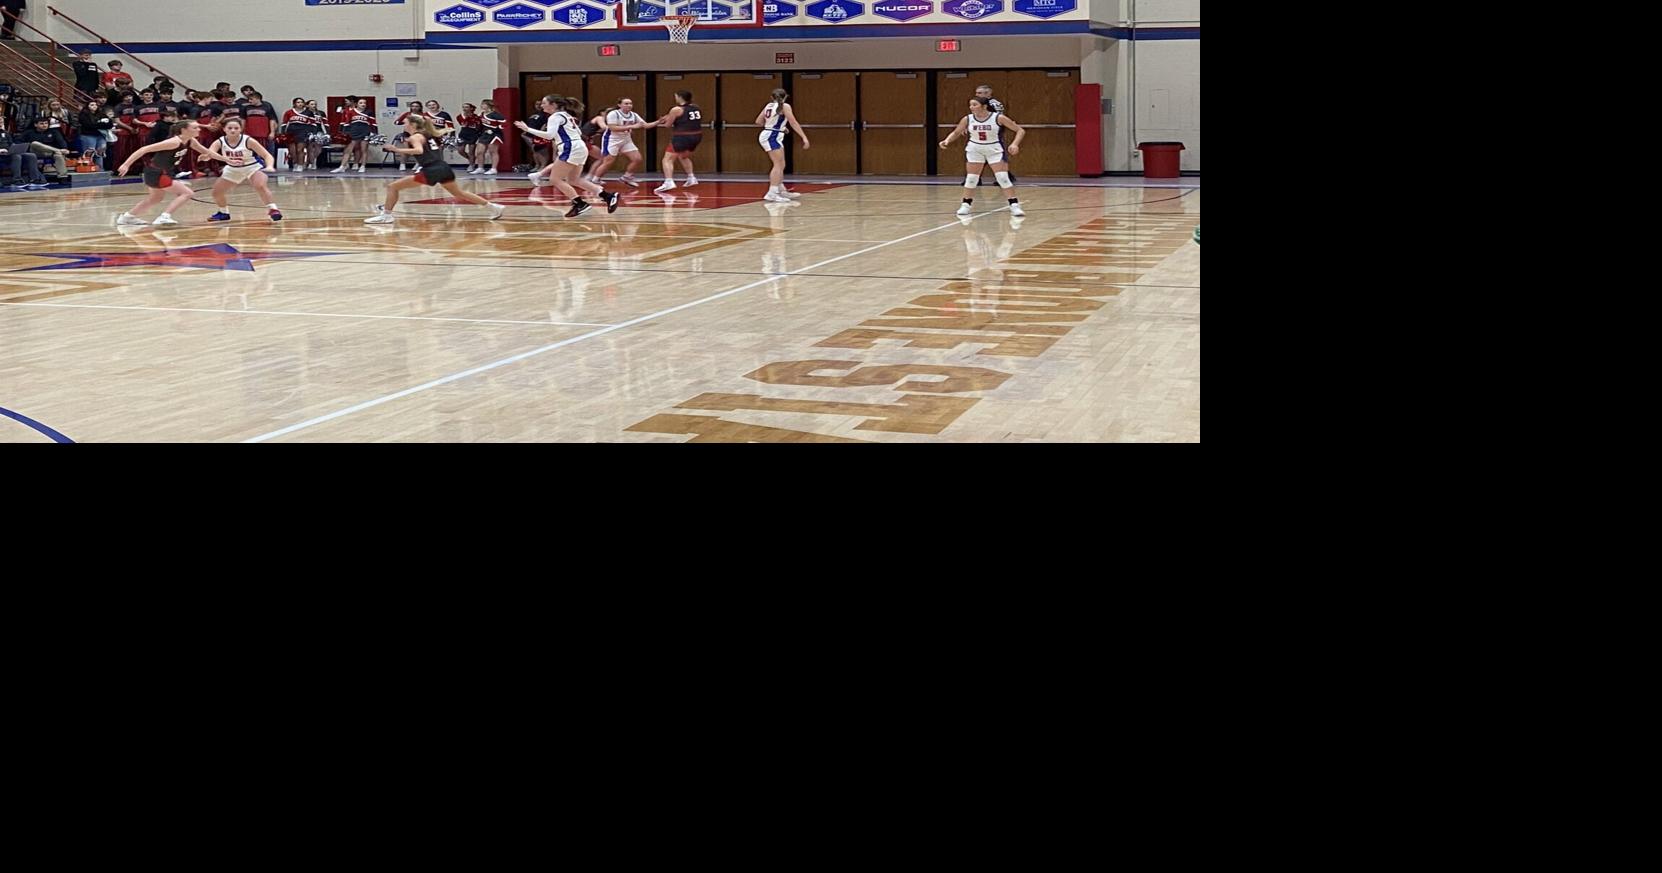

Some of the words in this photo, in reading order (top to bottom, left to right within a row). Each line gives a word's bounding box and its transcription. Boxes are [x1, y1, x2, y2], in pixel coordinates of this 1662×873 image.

[601, 46, 616, 56] EXIT
[689, 110, 702, 120] 33
[978, 132, 987, 141] 5
[812, 268, 1143, 357] BOONE
